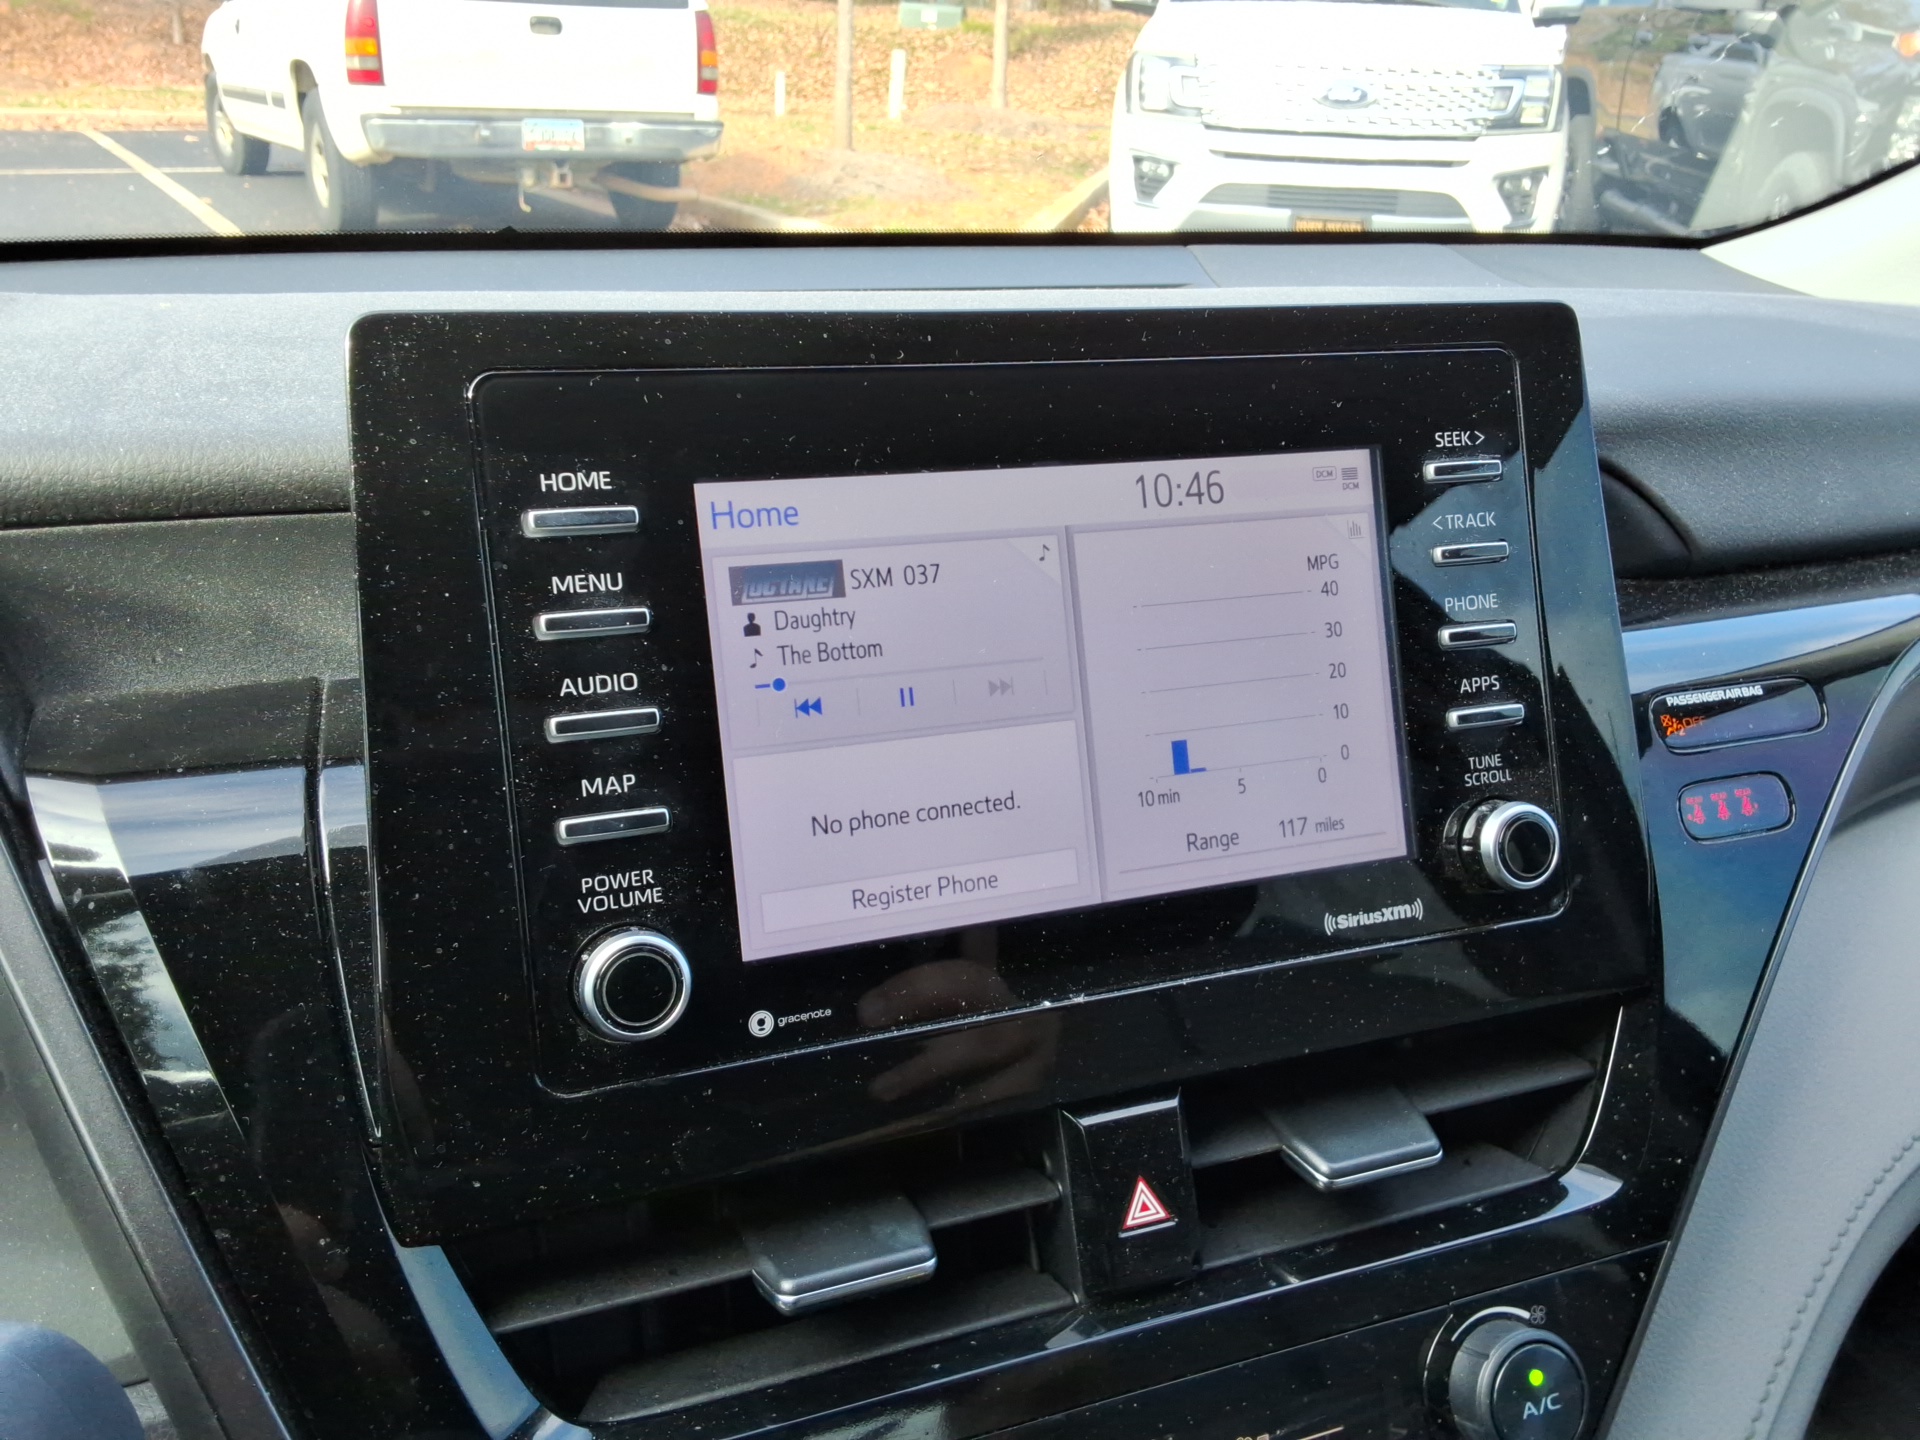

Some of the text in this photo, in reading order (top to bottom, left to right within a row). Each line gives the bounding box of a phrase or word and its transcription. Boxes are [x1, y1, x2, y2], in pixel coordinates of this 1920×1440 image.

[540, 471, 613, 492] HOME
[1315, 469, 1334, 480] DCM
[1135, 470, 1224, 508] 10:46
[1342, 482, 1359, 491] DCM
[710, 501, 800, 530] Home
[1307, 554, 1340, 571] MPG
[551, 572, 623, 594] MENU
[850, 564, 941, 590] SXM 037
[1320, 580, 1339, 596] 40
[1444, 593, 1499, 612] PHONE
[774, 608, 856, 633] Daughtry
[1325, 621, 1343, 638] 30
[777, 641, 883, 666] The Bottom
[1328, 662, 1346, 679] 20
[560, 672, 638, 697] AUDIO
[1460, 675, 1500, 694] APPS
[1666, 691, 1725, 706] PASSENGER
[1333, 703, 1349, 720] 10
[1340, 744, 1350, 761] 0
[1468, 753, 1503, 770] TUNE
[1318, 767, 1327, 783] 0
[1464, 769, 1512, 787] SCROLL
[581, 774, 636, 797] MAP
[1238, 778, 1247, 794] 5
[1137, 788, 1181, 808] 10 min
[811, 790, 1021, 836] No phone connected.
[1186, 817, 1345, 852] Range 117 miles
[581, 869, 654, 894] POWER
[852, 873, 999, 910] Register Phone
[577, 887, 663, 914] VOLUME
[777, 1007, 832, 1027] gracenote
[1522, 1392, 1562, 1420] A/C
